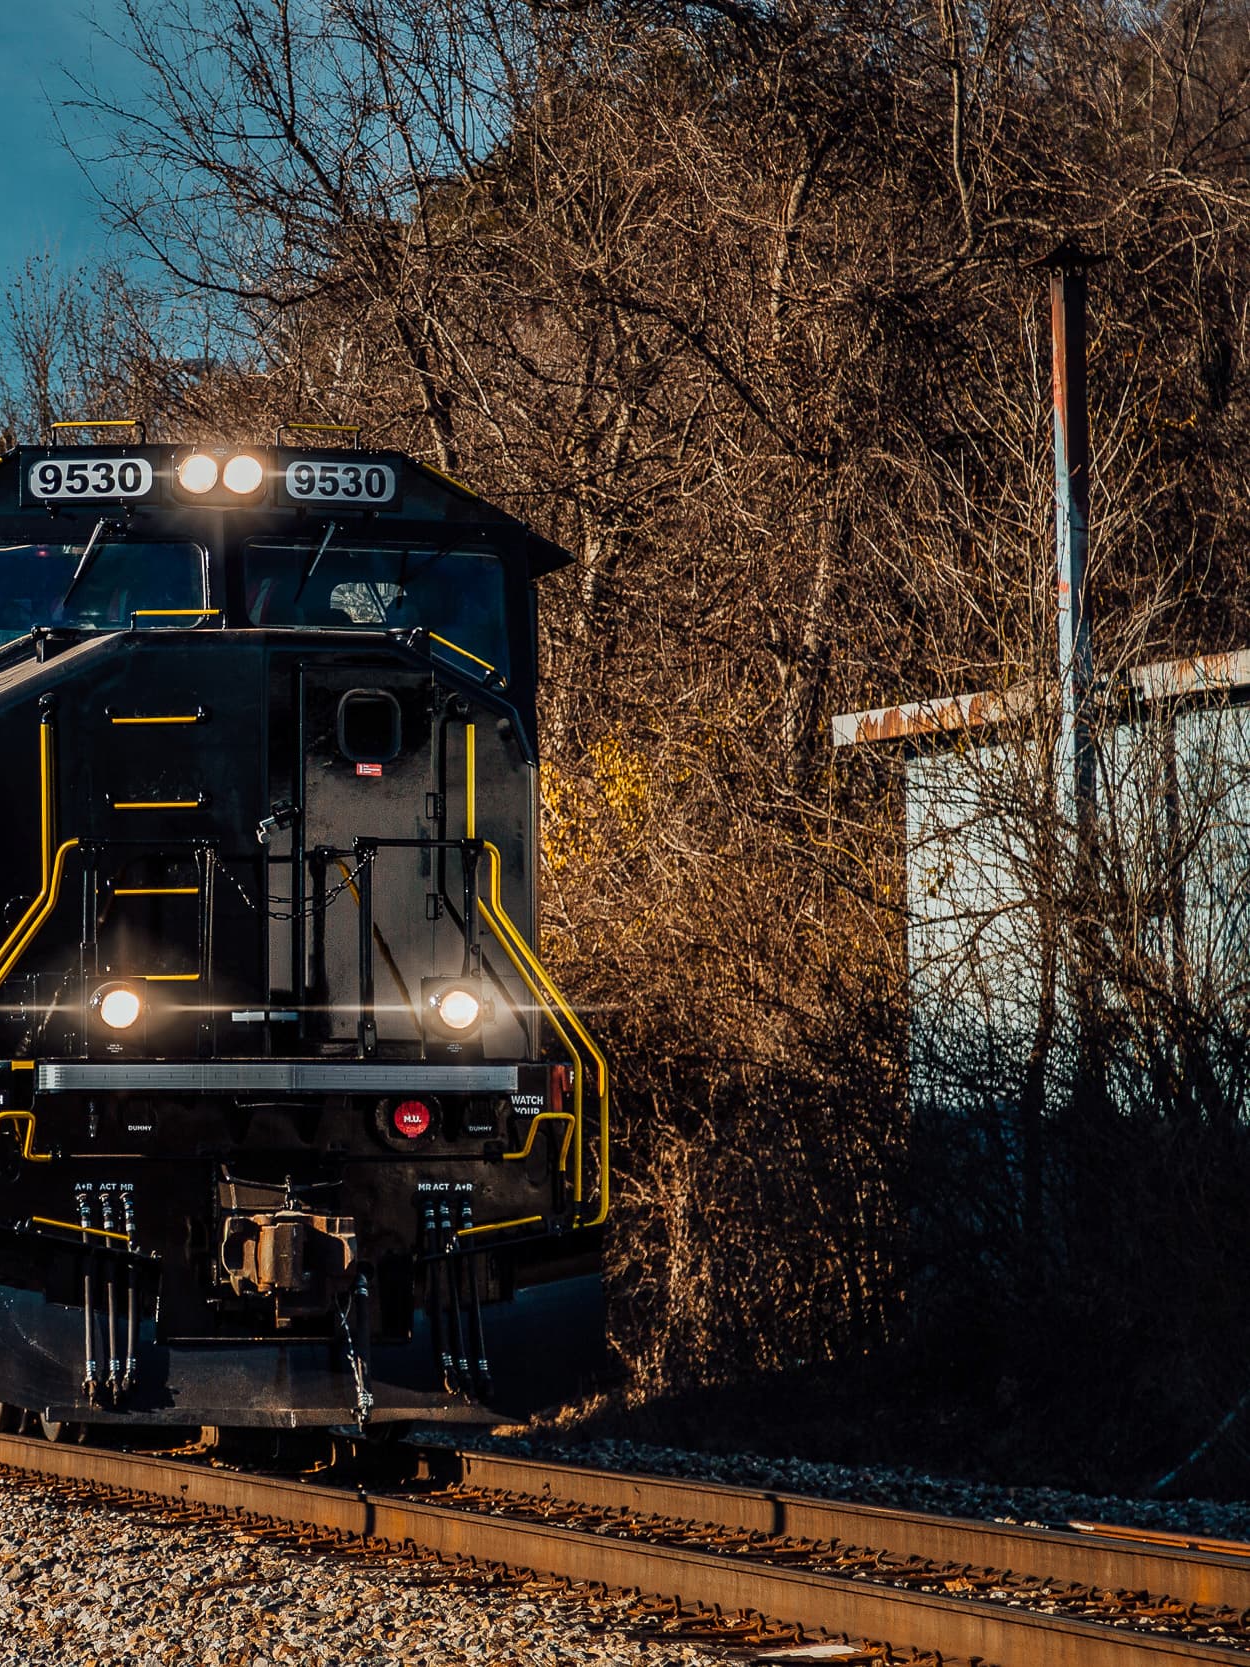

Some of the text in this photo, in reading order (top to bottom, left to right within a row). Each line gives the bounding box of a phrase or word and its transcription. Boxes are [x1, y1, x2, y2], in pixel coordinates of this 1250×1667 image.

[38, 462, 142, 494] 9530
[294, 464, 386, 498] 9530
[510, 1095, 544, 1105] WATCH
[403, 1114, 422, 1123] M.U.
[99, 1183, 117, 1191] ACT
[120, 1183, 134, 1191] MR
[417, 1183, 432, 1191] MR
[432, 1183, 450, 1191] ACT
